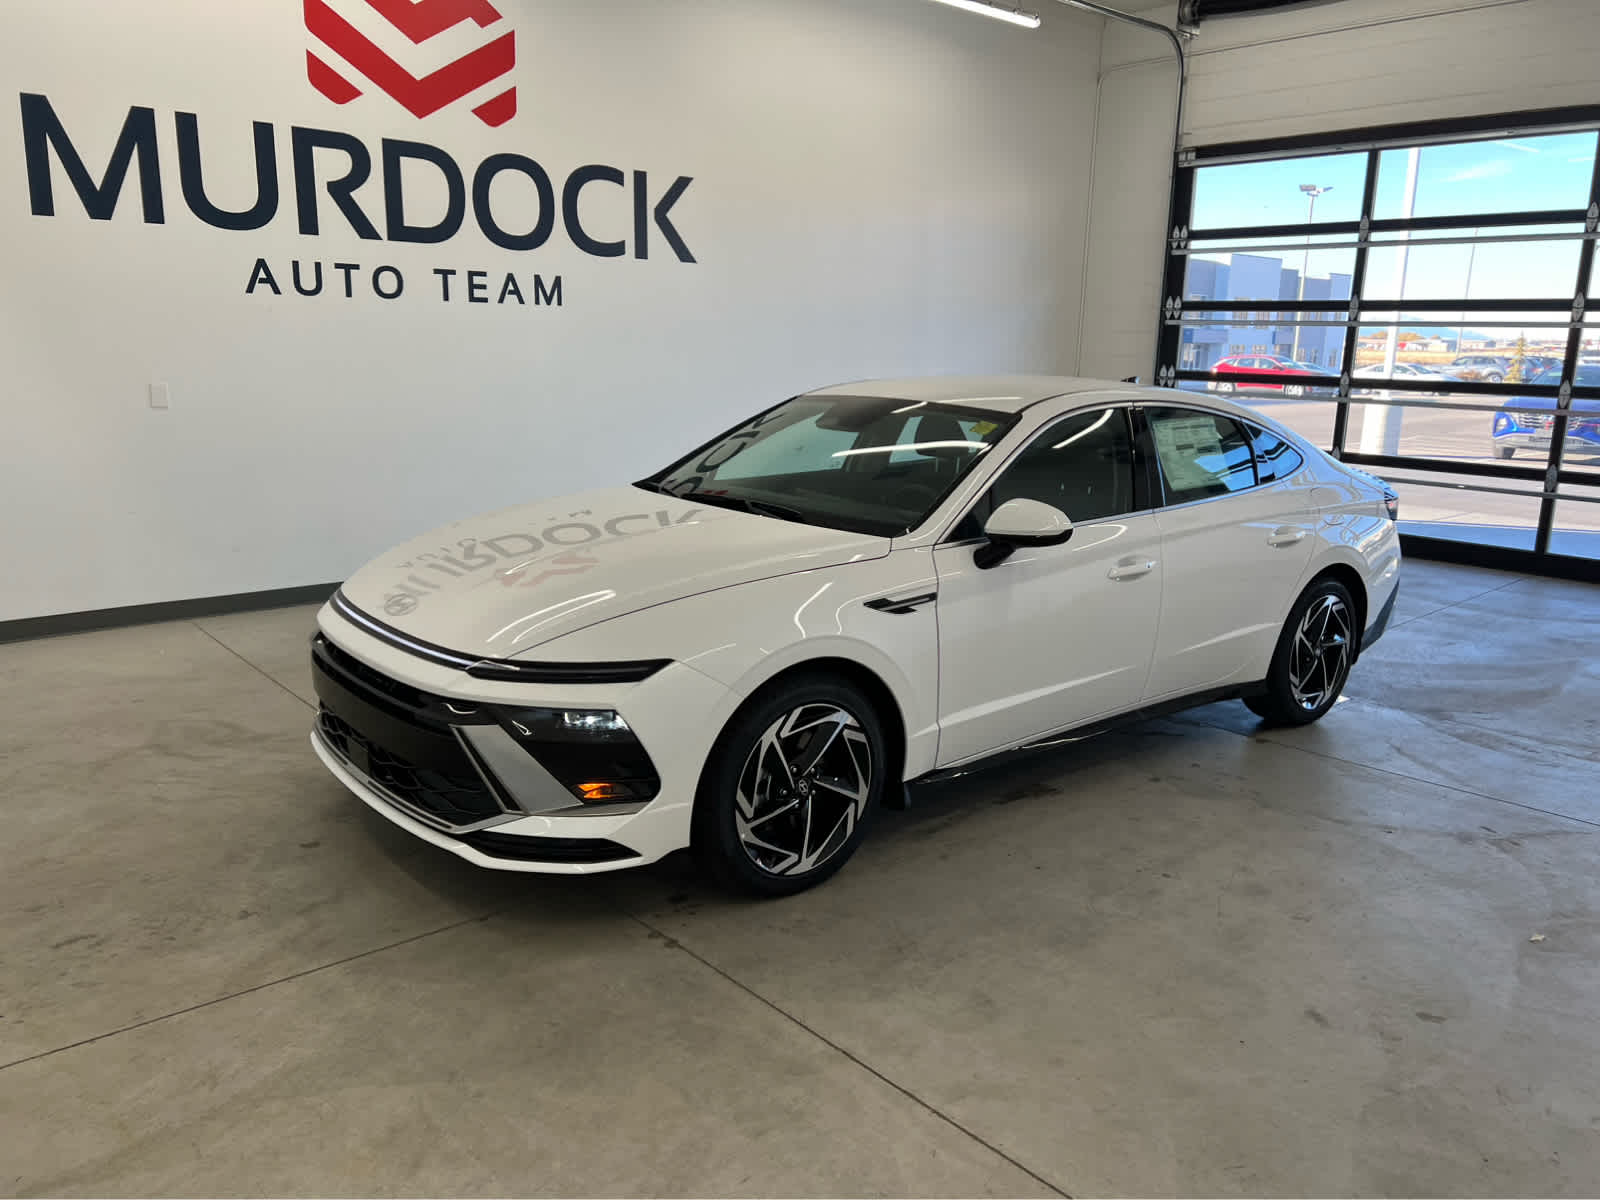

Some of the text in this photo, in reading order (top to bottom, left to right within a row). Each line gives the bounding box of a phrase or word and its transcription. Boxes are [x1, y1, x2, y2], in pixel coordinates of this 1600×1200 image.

[20, 92, 697, 263] MURDOCK
[246, 258, 563, 307] AUTO TEAM
